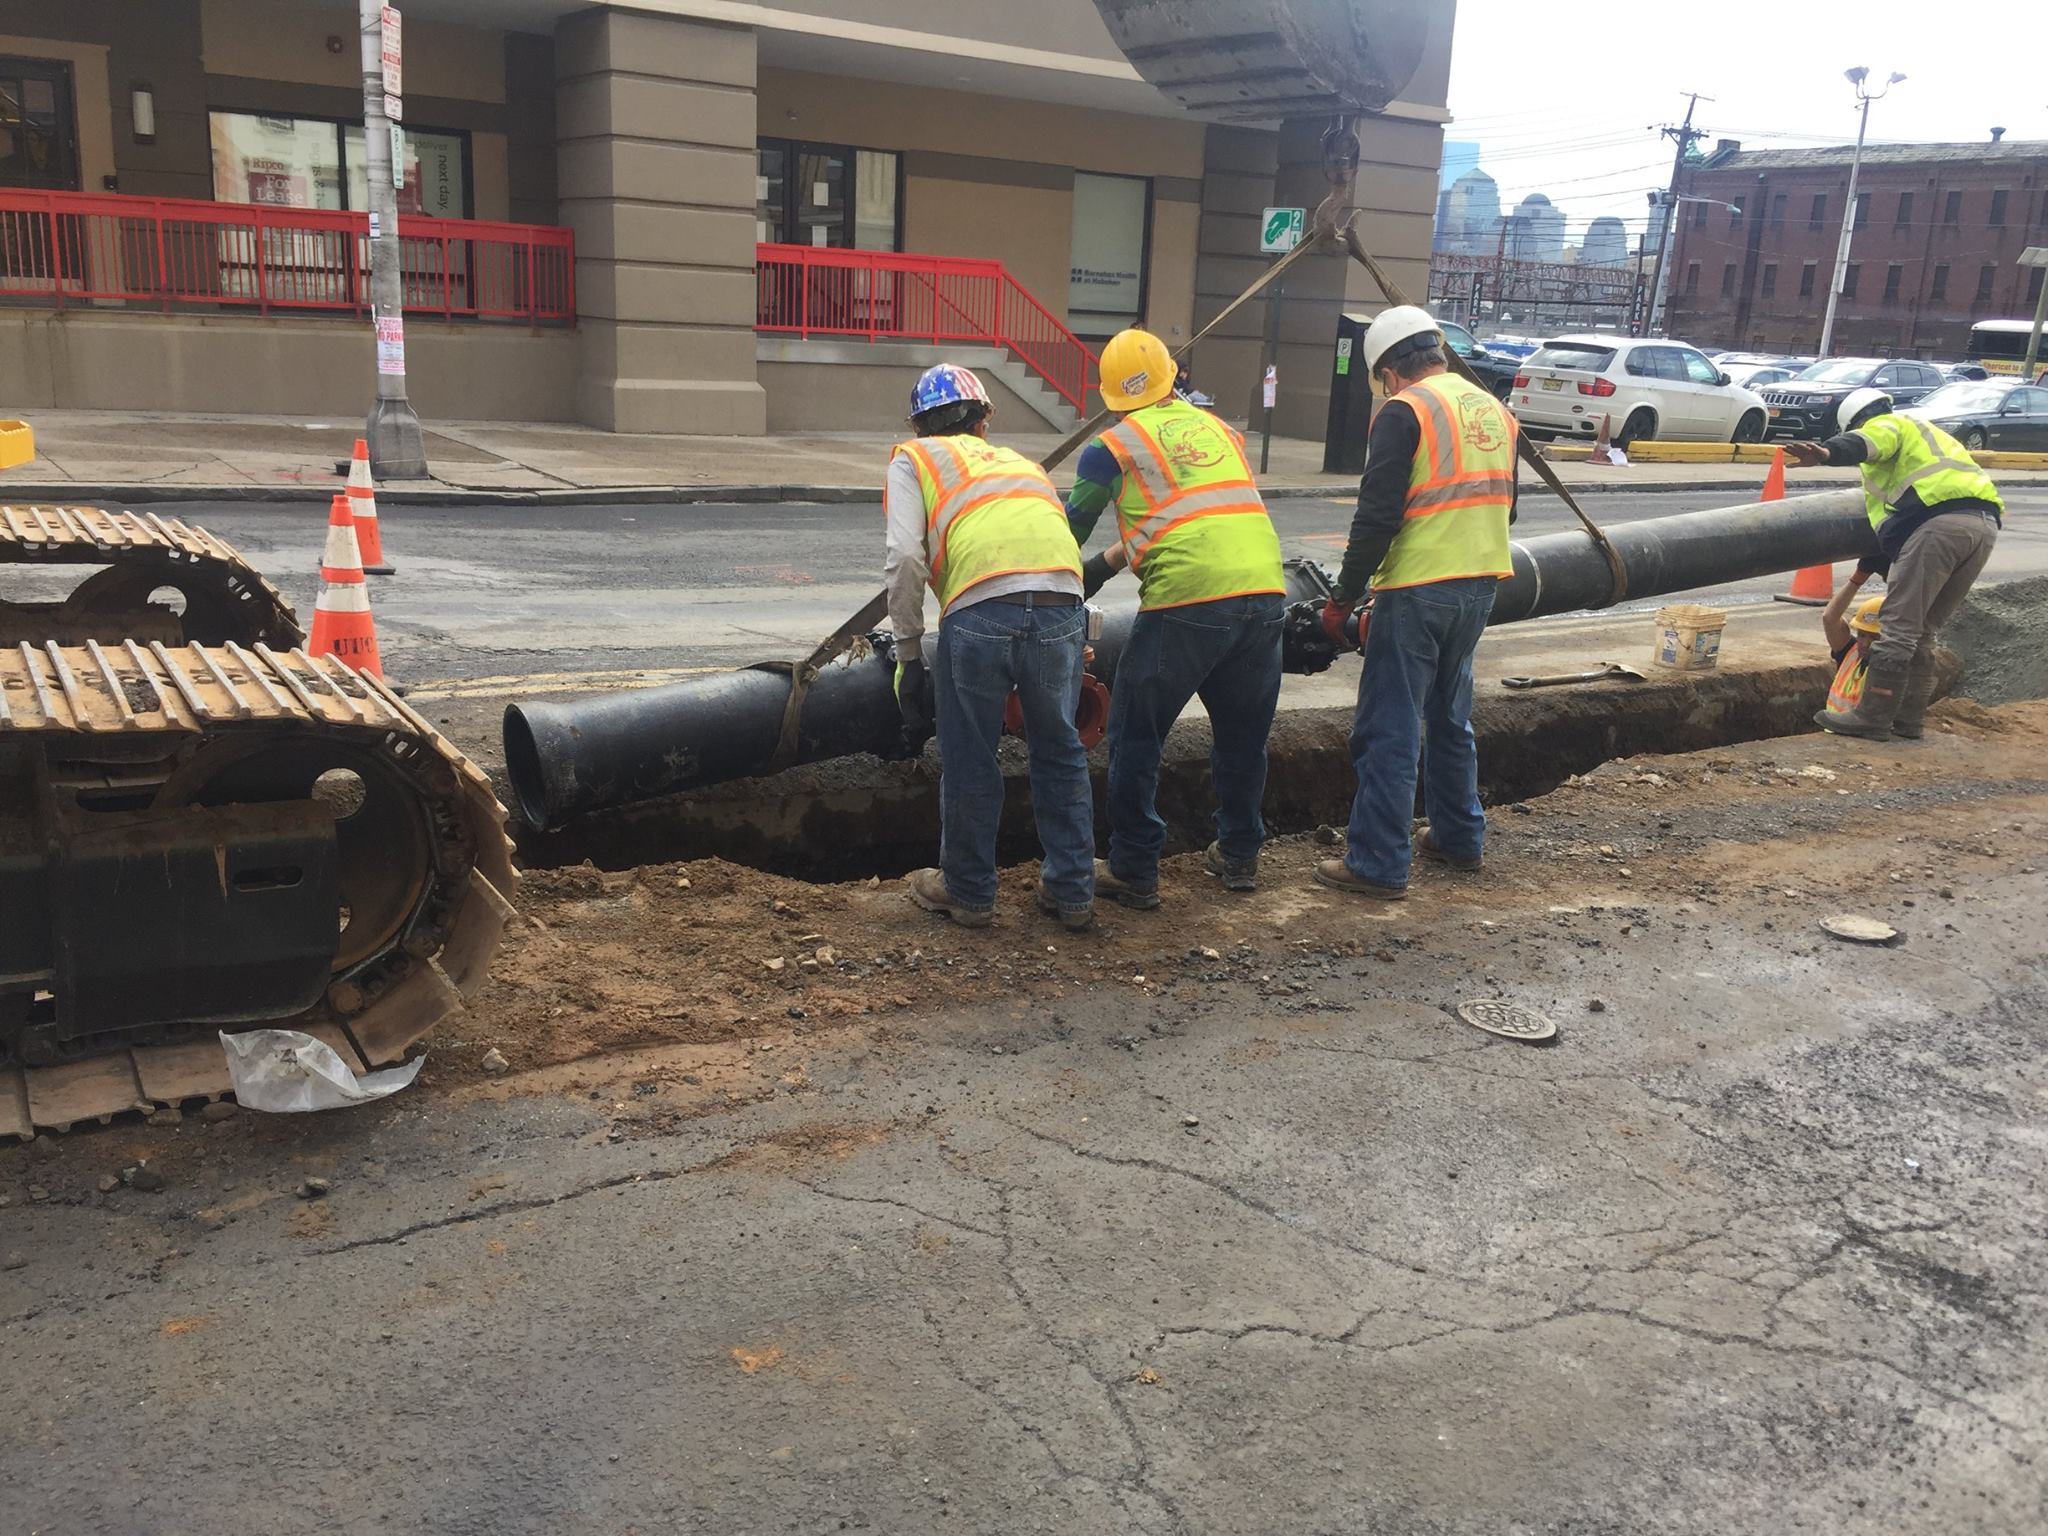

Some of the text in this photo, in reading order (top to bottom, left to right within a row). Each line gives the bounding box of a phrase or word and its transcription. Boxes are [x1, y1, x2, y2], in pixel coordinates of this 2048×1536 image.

[252, 159, 285, 173] Ripco
[437, 154, 449, 183] next
[265, 175, 289, 189] For
[256, 187, 304, 203] Lease
[1293, 210, 1301, 227] 2
[1472, 283, 1480, 315] PARK
